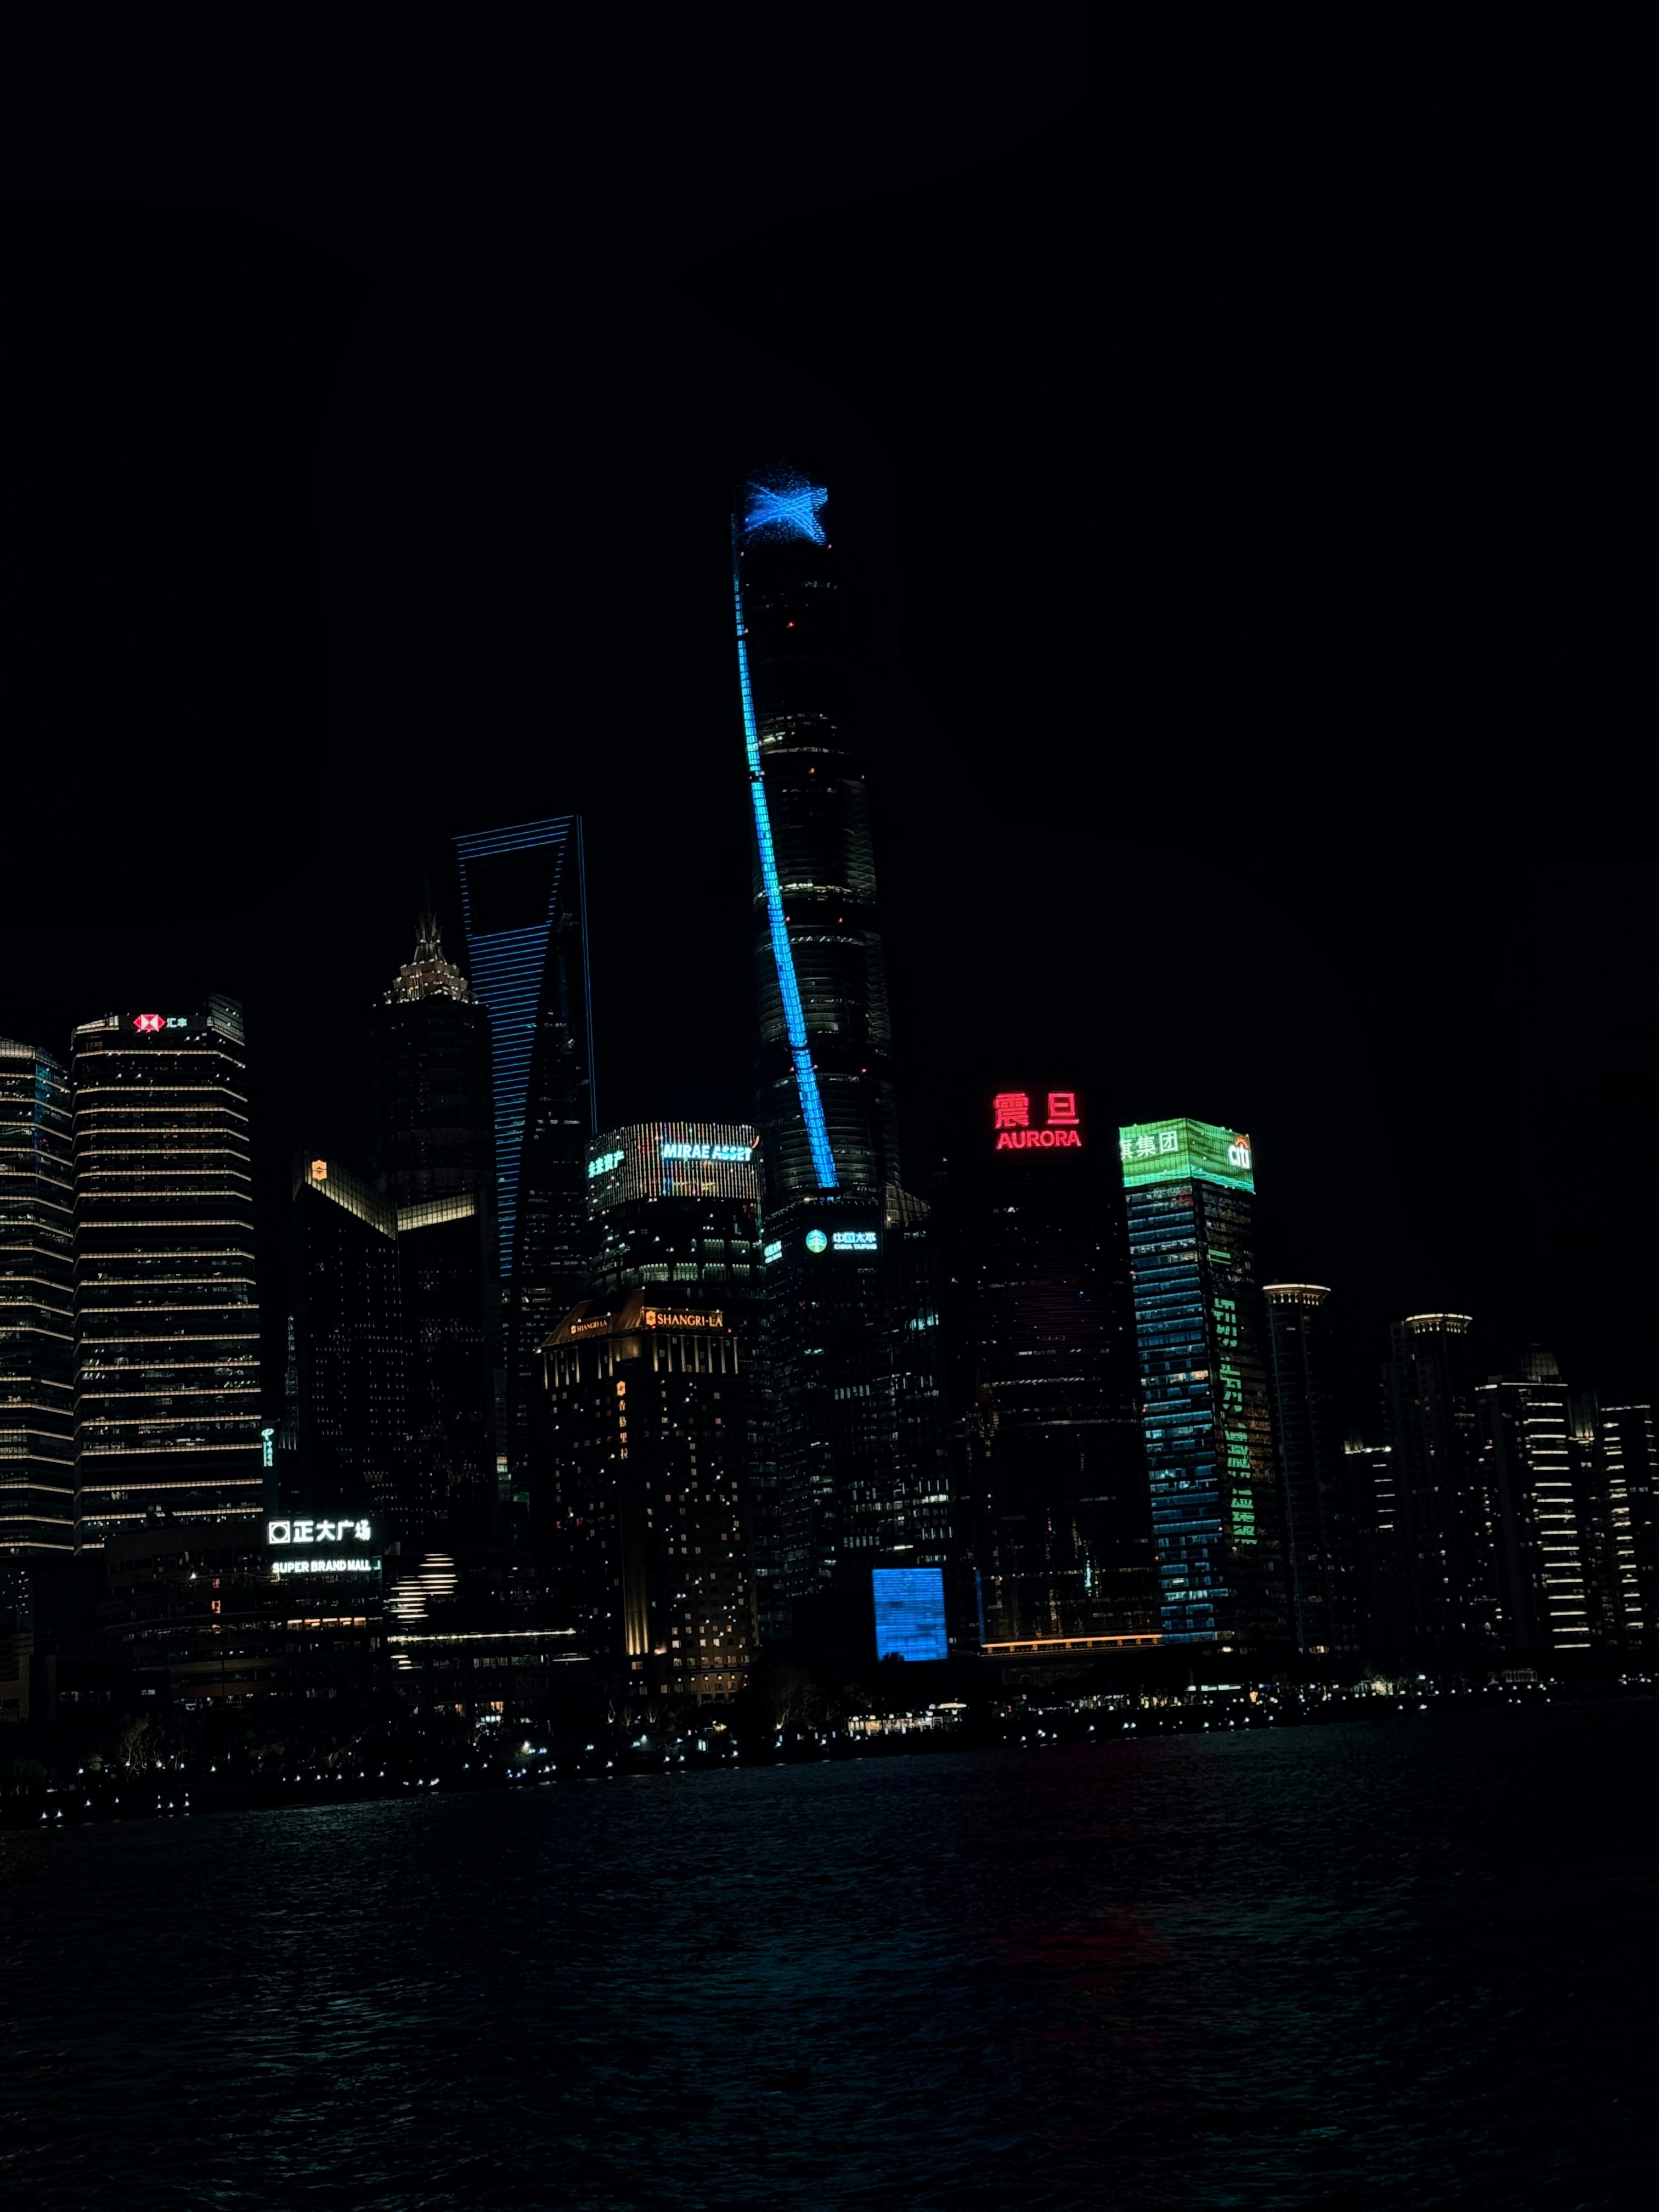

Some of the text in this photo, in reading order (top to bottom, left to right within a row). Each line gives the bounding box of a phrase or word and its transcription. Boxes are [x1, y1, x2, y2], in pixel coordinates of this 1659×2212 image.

[995, 1093, 1080, 1129] 震旦
[996, 1131, 1082, 1150] AURORA
[663, 1144, 752, 1161] MIRAE ASSET
[833, 1232, 877, 1243] 中国太平
[658, 1314, 723, 1327] SHANGRI-LA
[292, 1519, 371, 1543] 正大广场
[272, 1559, 371, 1573] SUPER BRAND MALL
